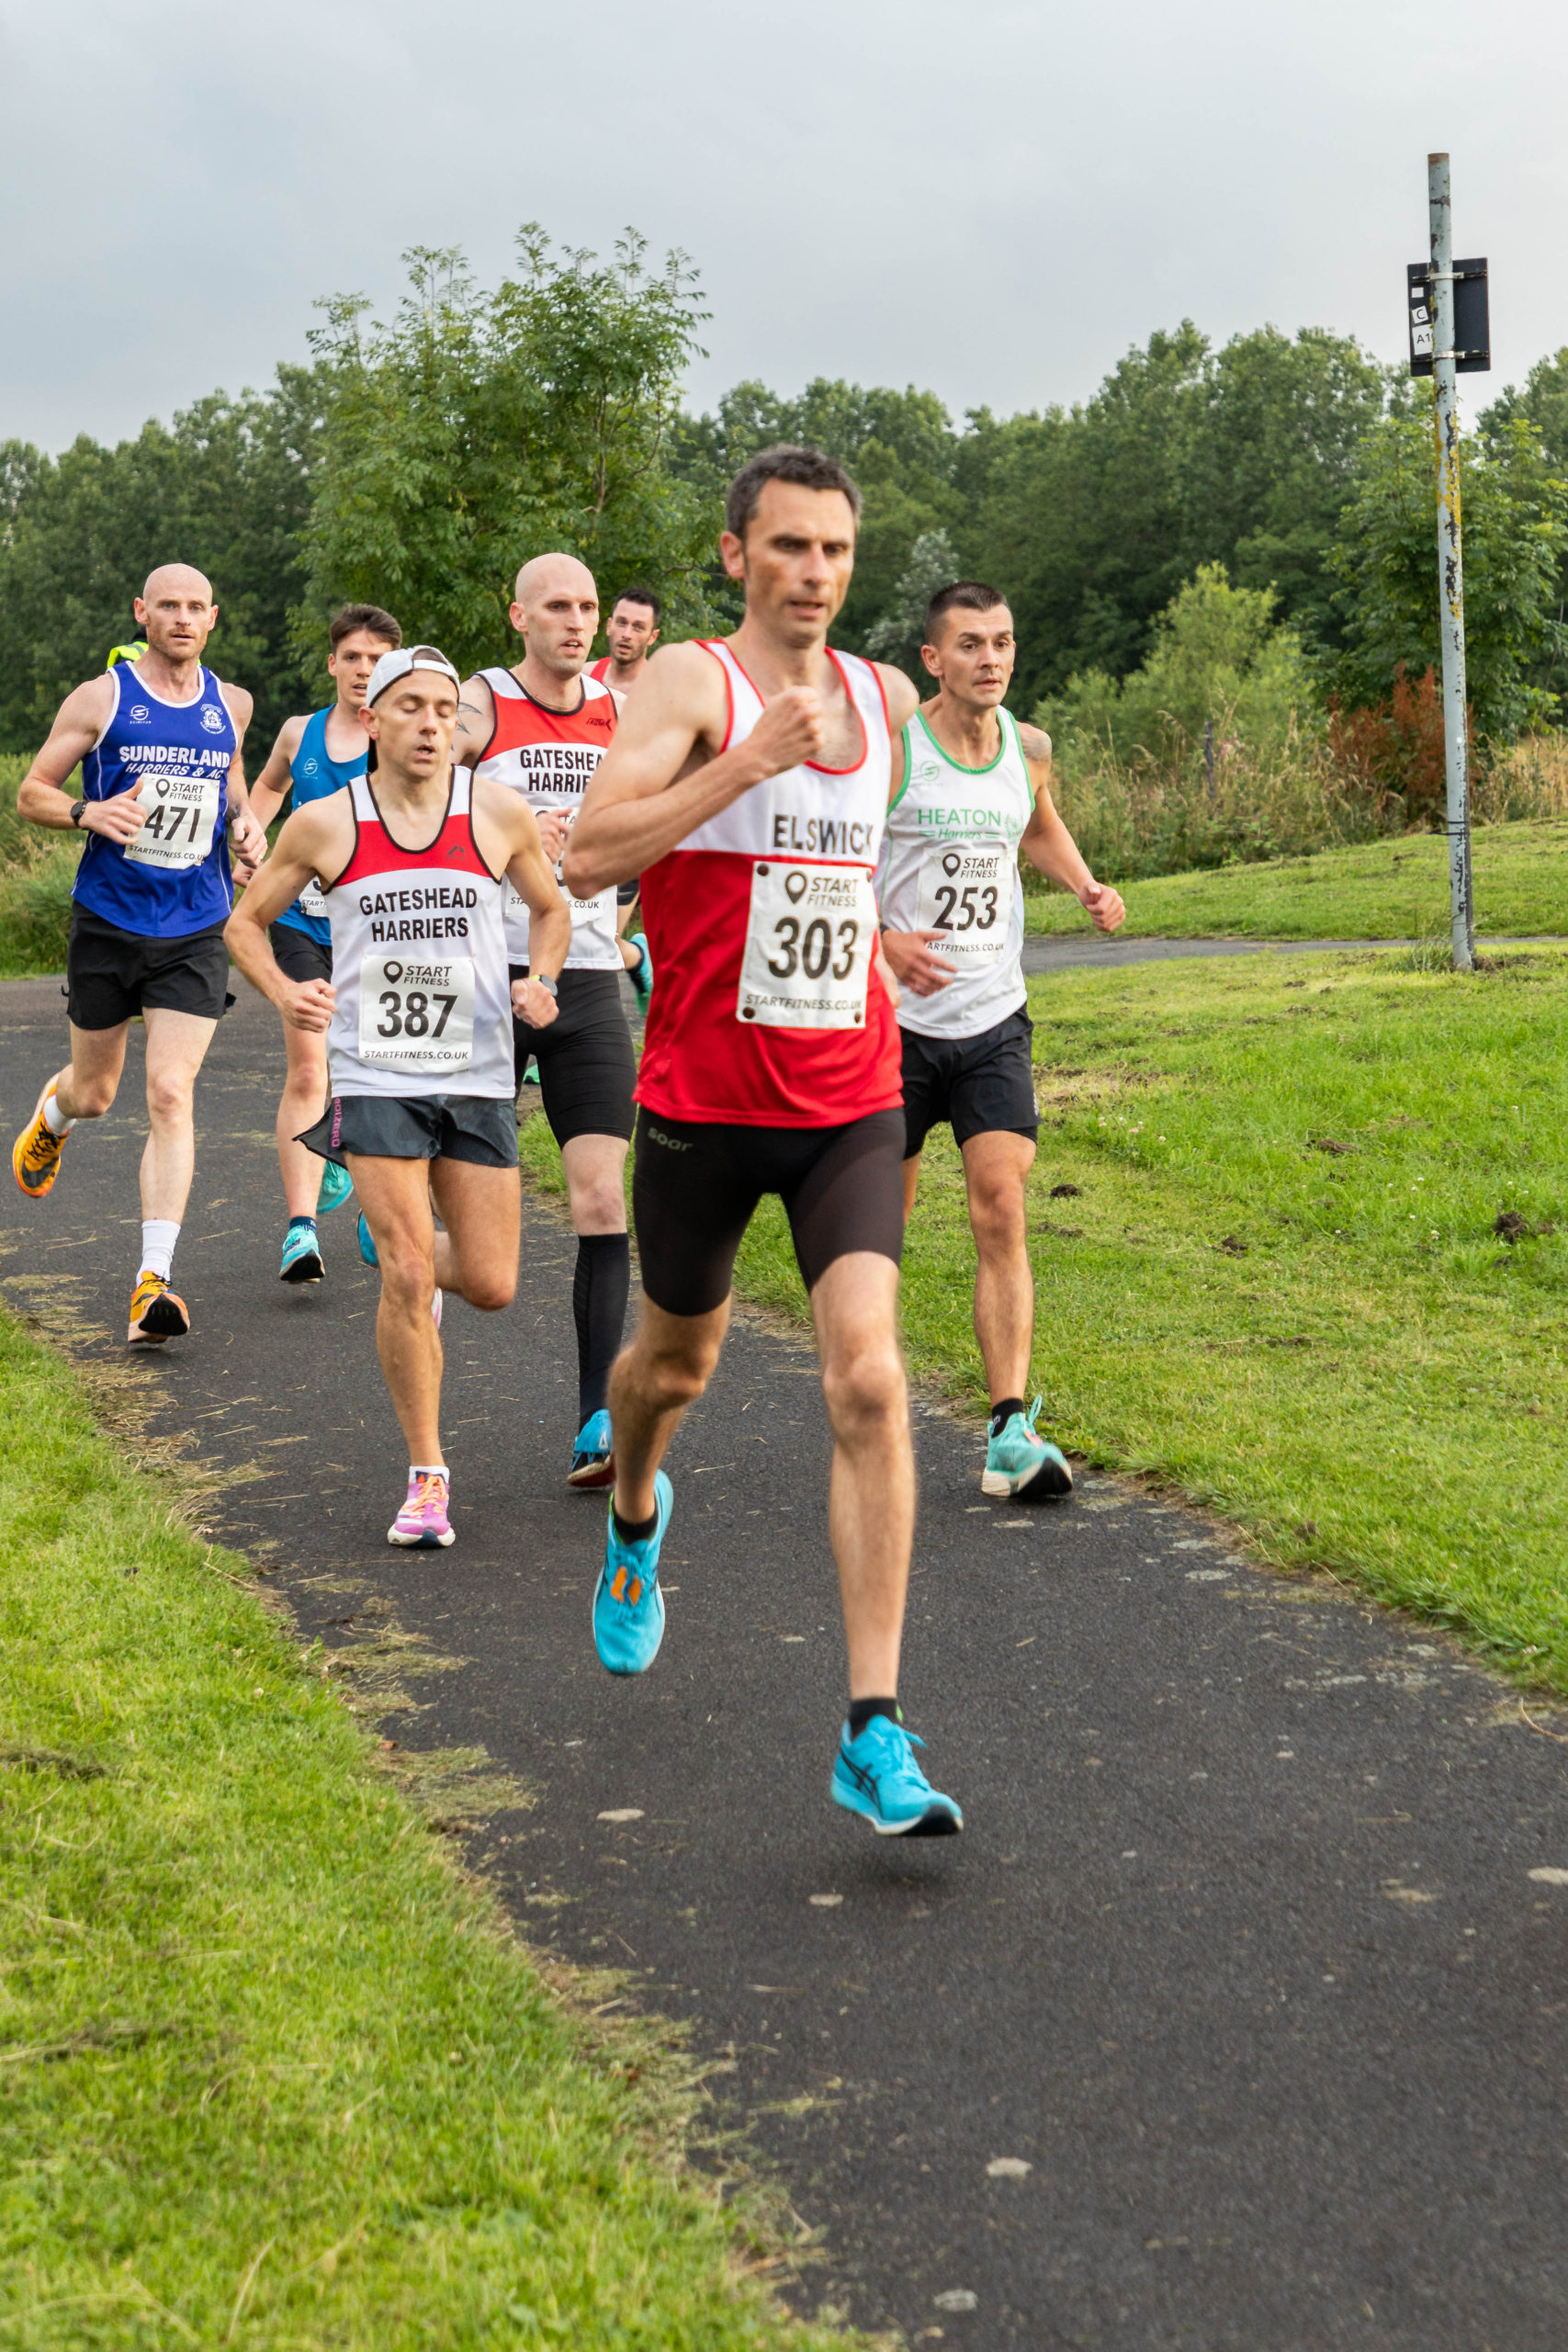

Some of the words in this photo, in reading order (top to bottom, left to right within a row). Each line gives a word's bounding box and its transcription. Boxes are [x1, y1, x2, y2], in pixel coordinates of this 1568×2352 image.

[1416, 309, 1426, 320] C
[1416, 333, 1433, 344] A1
[118, 745, 231, 769] SUNDERLAND
[520, 749, 604, 772] GATESHEA
[125, 763, 190, 776] HARRIERS
[191, 766, 205, 777] &
[207, 768, 224, 780] AC
[172, 782, 205, 794] START
[528, 772, 592, 794] HARRIE
[169, 792, 203, 802] FITNESS
[144, 804, 201, 842] 471
[918, 808, 1001, 827] HEATON
[773, 813, 874, 855] ELSWICK
[938, 828, 982, 840] Harriers
[963, 857, 999, 869] START
[960, 869, 998, 878] FITNESS
[810, 876, 859, 893] START
[359, 887, 478, 916] GATESHEAD
[807, 894, 857, 907] FITNESS
[931, 886, 998, 932] 253
[371, 917, 468, 942] HARRIERS
[768, 916, 859, 980] 303
[927, 942, 1004, 953] ARTFITNESS.CO.UK
[405, 965, 452, 977] START
[403, 976, 450, 987] FITNESS
[745, 993, 863, 1011] STARTFITNESS.CO.UK
[377, 990, 458, 1038] 387
[364, 1050, 468, 1059] STARTFITNESS.CO.UK
[648, 1126, 694, 1152] soar
